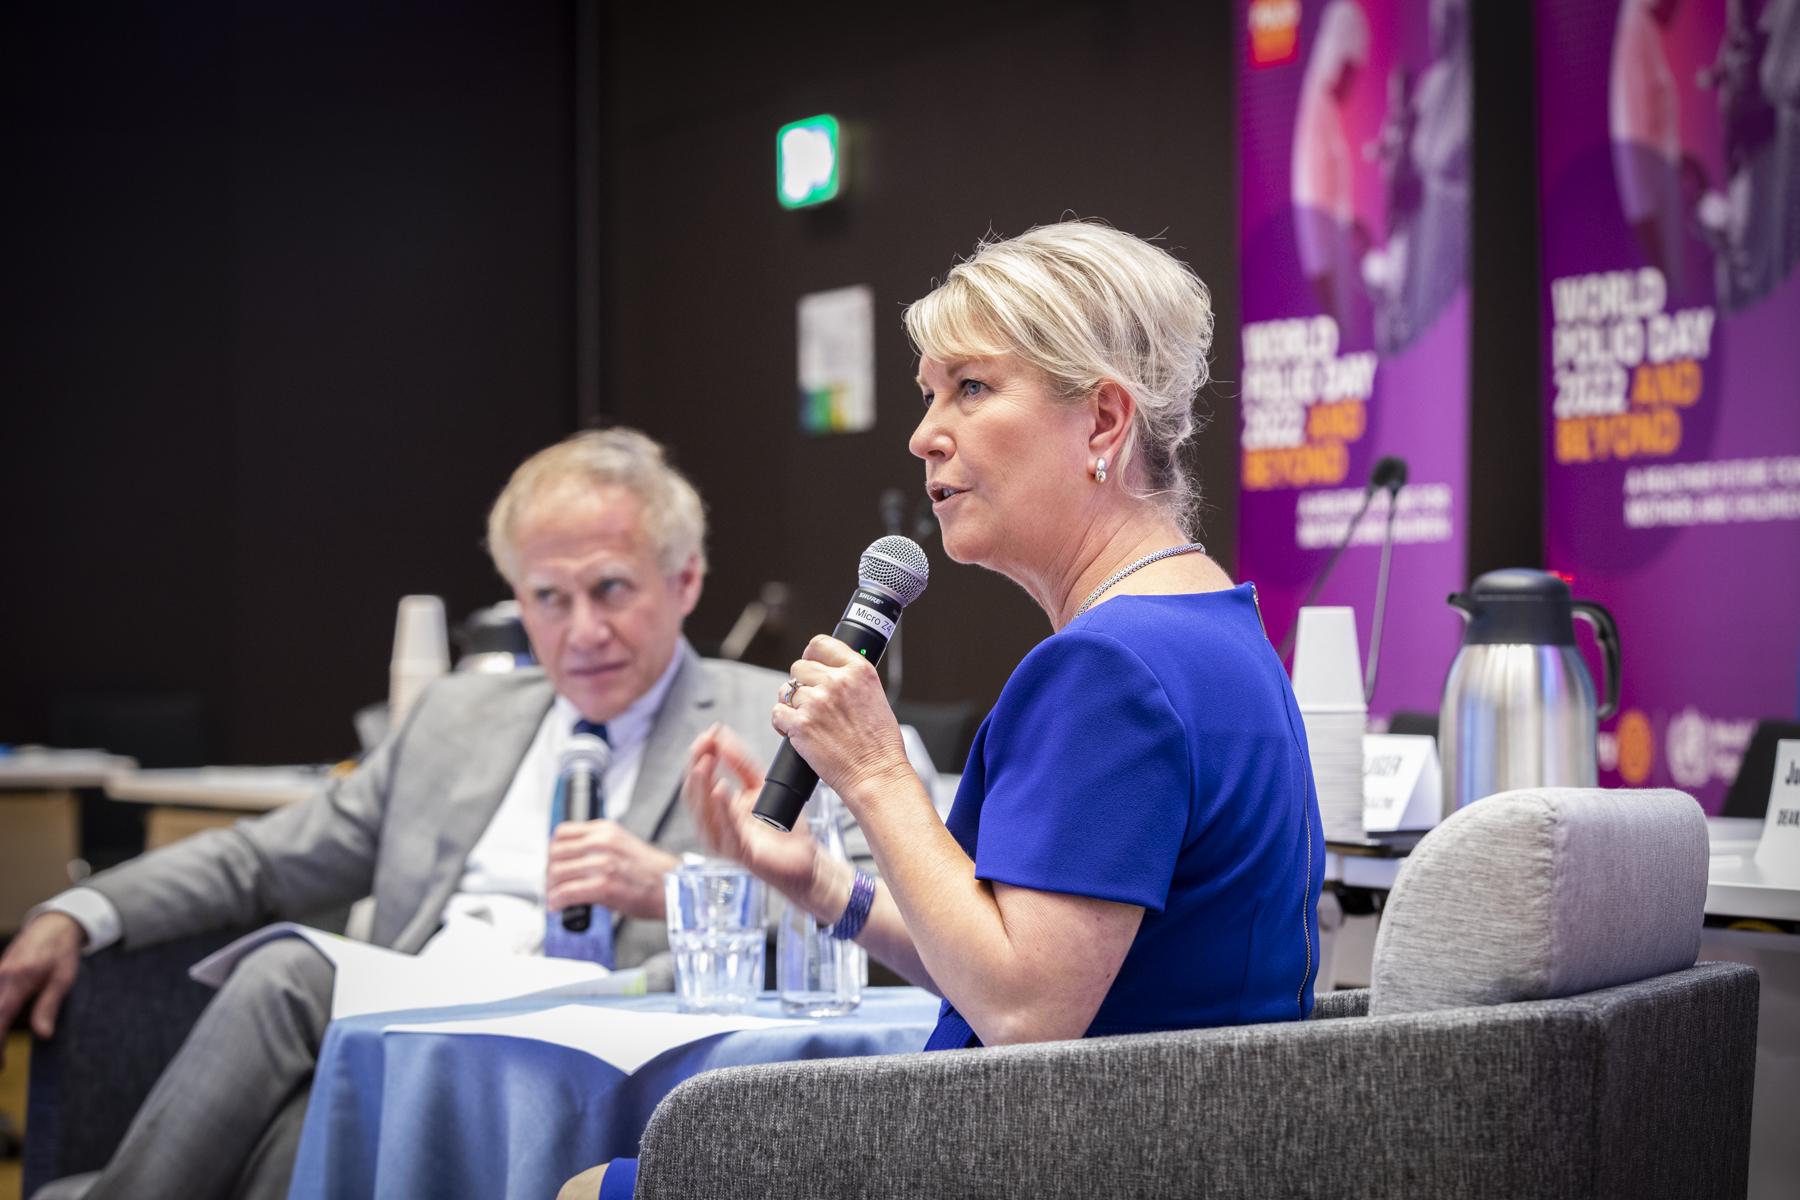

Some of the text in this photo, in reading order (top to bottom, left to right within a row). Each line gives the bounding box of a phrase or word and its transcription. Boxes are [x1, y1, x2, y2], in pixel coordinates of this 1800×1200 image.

[1552, 265, 1667, 322] WORLD
[1242, 314, 1339, 362] WORLD
[1552, 305, 1715, 368] POLIO DAY
[1553, 358, 1702, 419] 2022 AND
[1306, 399, 1367, 445] AND
[1555, 407, 1682, 465] BEYOND
[855, 607, 881, 626] Micro
